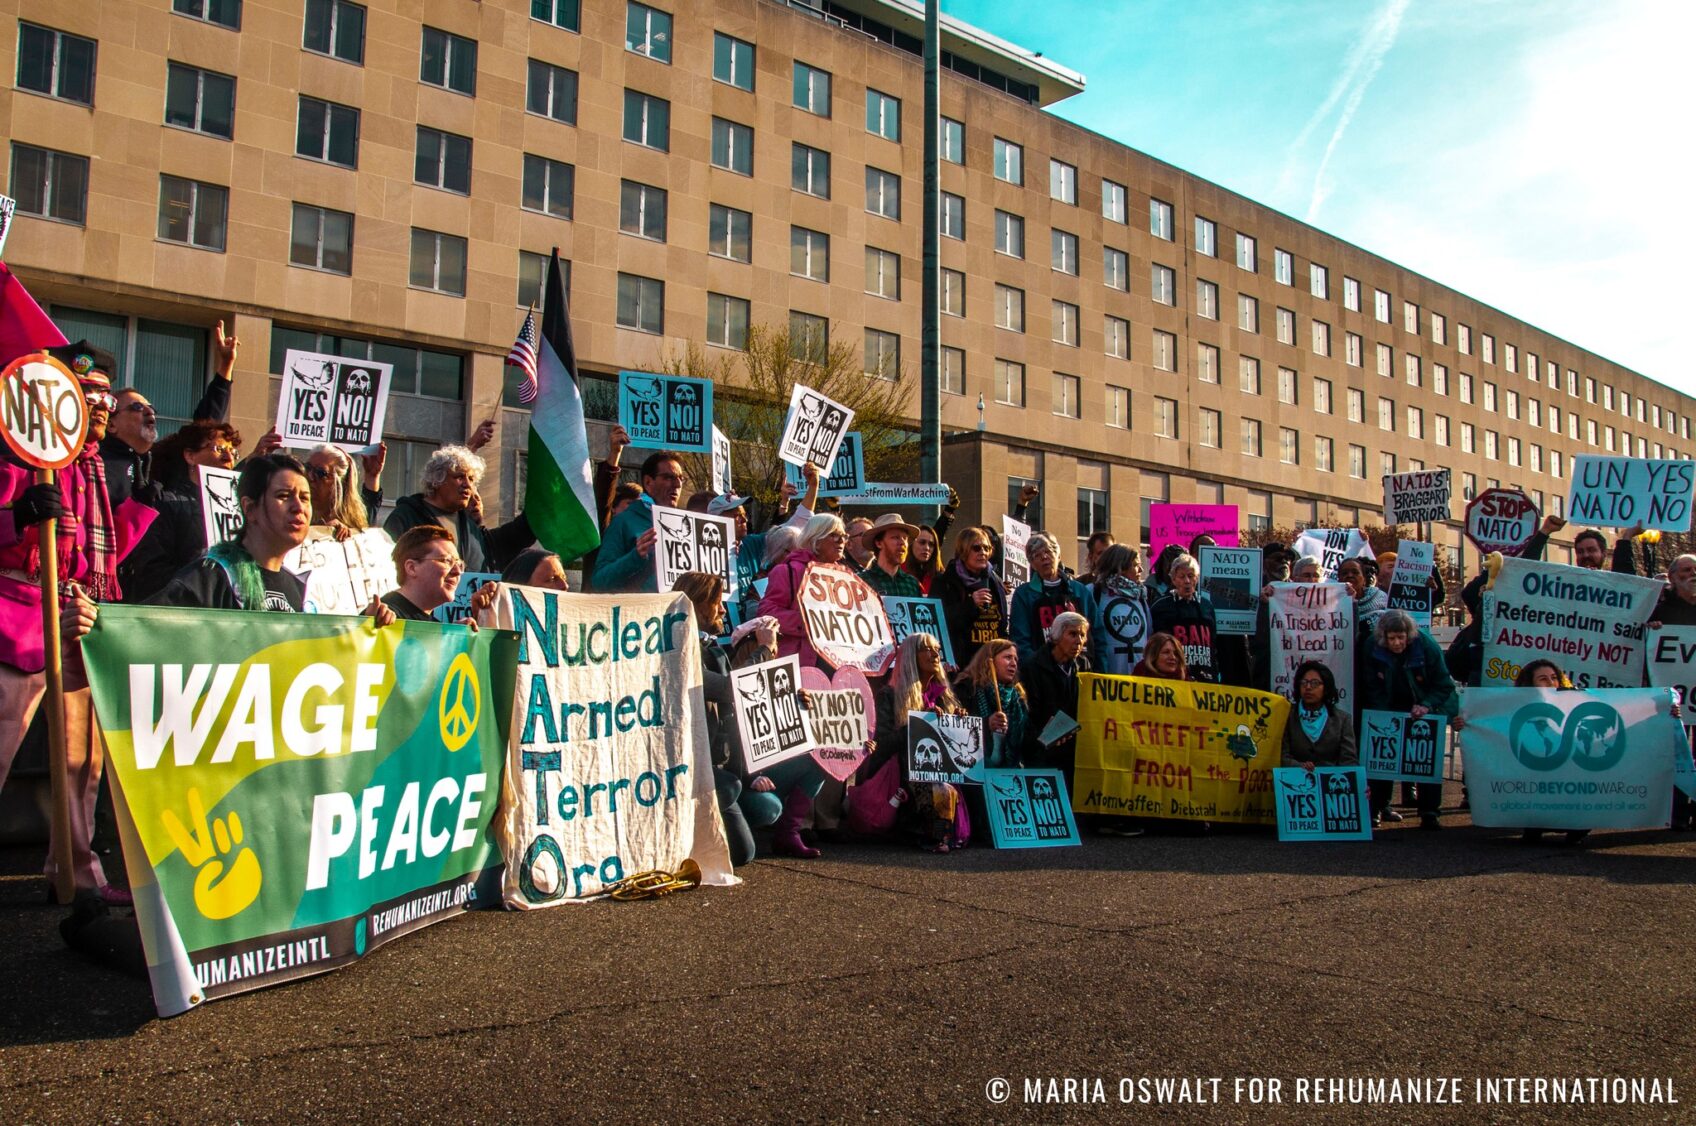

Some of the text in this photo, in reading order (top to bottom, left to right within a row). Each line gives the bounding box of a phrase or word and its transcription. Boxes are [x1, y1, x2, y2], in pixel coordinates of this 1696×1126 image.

[4, 367, 81, 450] NATO
[294, 387, 328, 422] YES
[337, 393, 373, 428] NO!
[631, 400, 660, 426] YES
[670, 403, 699, 431] NO!
[290, 422, 325, 438] TO PEACE
[334, 427, 368, 441] TO NATO
[631, 427, 660, 439] TO PEACE
[670, 430, 700, 442] TO NATO
[793, 416, 814, 445] YES
[813, 426, 837, 456] NO!
[829, 479, 837, 488] TO
[840, 479, 855, 488] NATO
[1583, 461, 1691, 494] UN YES
[1392, 489, 1448, 510] BRAGGART
[1480, 495, 1532, 520] STOP
[1570, 491, 1686, 525] NATO NO
[1012, 525, 1021, 536] No
[1156, 527, 1168, 538] US
[1477, 517, 1522, 541] NATO
[665, 540, 692, 571] YES
[699, 544, 726, 577] NO!
[1005, 548, 1014, 559] No
[1212, 552, 1249, 564] NATO
[1322, 549, 1344, 571] YES
[1410, 547, 1424, 558] No
[667, 571, 675, 583] TO
[1012, 564, 1022, 576] No
[1211, 568, 1249, 576] means
[1398, 559, 1431, 572] Racism
[1394, 572, 1426, 584] No Wa
[808, 572, 868, 612] STOP
[1295, 584, 1327, 609] 9/11
[1401, 586, 1417, 596] No
[1522, 572, 1633, 609] Okinawan
[1391, 597, 1427, 610] NATO
[509, 587, 688, 668] Nuclear
[1112, 615, 1139, 626] NATO
[1271, 611, 1349, 630] An Inside Job
[1496, 601, 1605, 633] Referendum
[1613, 622, 1644, 641] said
[889, 622, 908, 646] ES
[1173, 625, 1211, 646] BAN
[1297, 634, 1327, 651] Lead
[1333, 635, 1345, 650] to
[1182, 645, 1211, 657] UCLEAR
[1496, 628, 1633, 665] Absolutely NOT
[1185, 655, 1211, 667] EAPONS
[1487, 657, 1521, 680] Sto
[808, 691, 864, 719] AY NO TO
[1091, 678, 1177, 708] NUCLEAR
[1193, 690, 1272, 718] WEAPONS
[129, 662, 386, 770] WAGE
[745, 702, 771, 740] YES
[774, 692, 800, 730] NO!
[937, 714, 982, 730] YES TO PEACE
[780, 728, 804, 746] TO NATO
[1104, 718, 1210, 750] A THEFT
[752, 738, 776, 756] TO PEACE
[1371, 736, 1397, 760] YES
[1405, 738, 1433, 763] NO!
[909, 770, 964, 783] NOTONATO.ORG
[1133, 758, 1193, 791] FROM
[1207, 764, 1230, 781] the
[1369, 761, 1396, 771] TO PEACE
[1404, 763, 1432, 774] TO NATO
[522, 750, 688, 825] Terror
[1490, 781, 1648, 798] WORLDBEYONDWAR.org
[999, 799, 1028, 825] YES
[1032, 799, 1064, 825] NO!
[1170, 798, 1217, 817] Diebstahl
[1287, 794, 1316, 819] YES
[1325, 793, 1356, 819] NO!
[305, 773, 487, 891] PEACE
[1005, 827, 1032, 838] TO PEACE
[1038, 826, 1067, 837] TO NATO
[1289, 821, 1319, 830] TO PEACE
[1327, 820, 1358, 830] TO NATO
[373, 881, 477, 936] REHUMANIZEINTL.ORG
[195, 936, 331, 988] UMANIZEINTL
